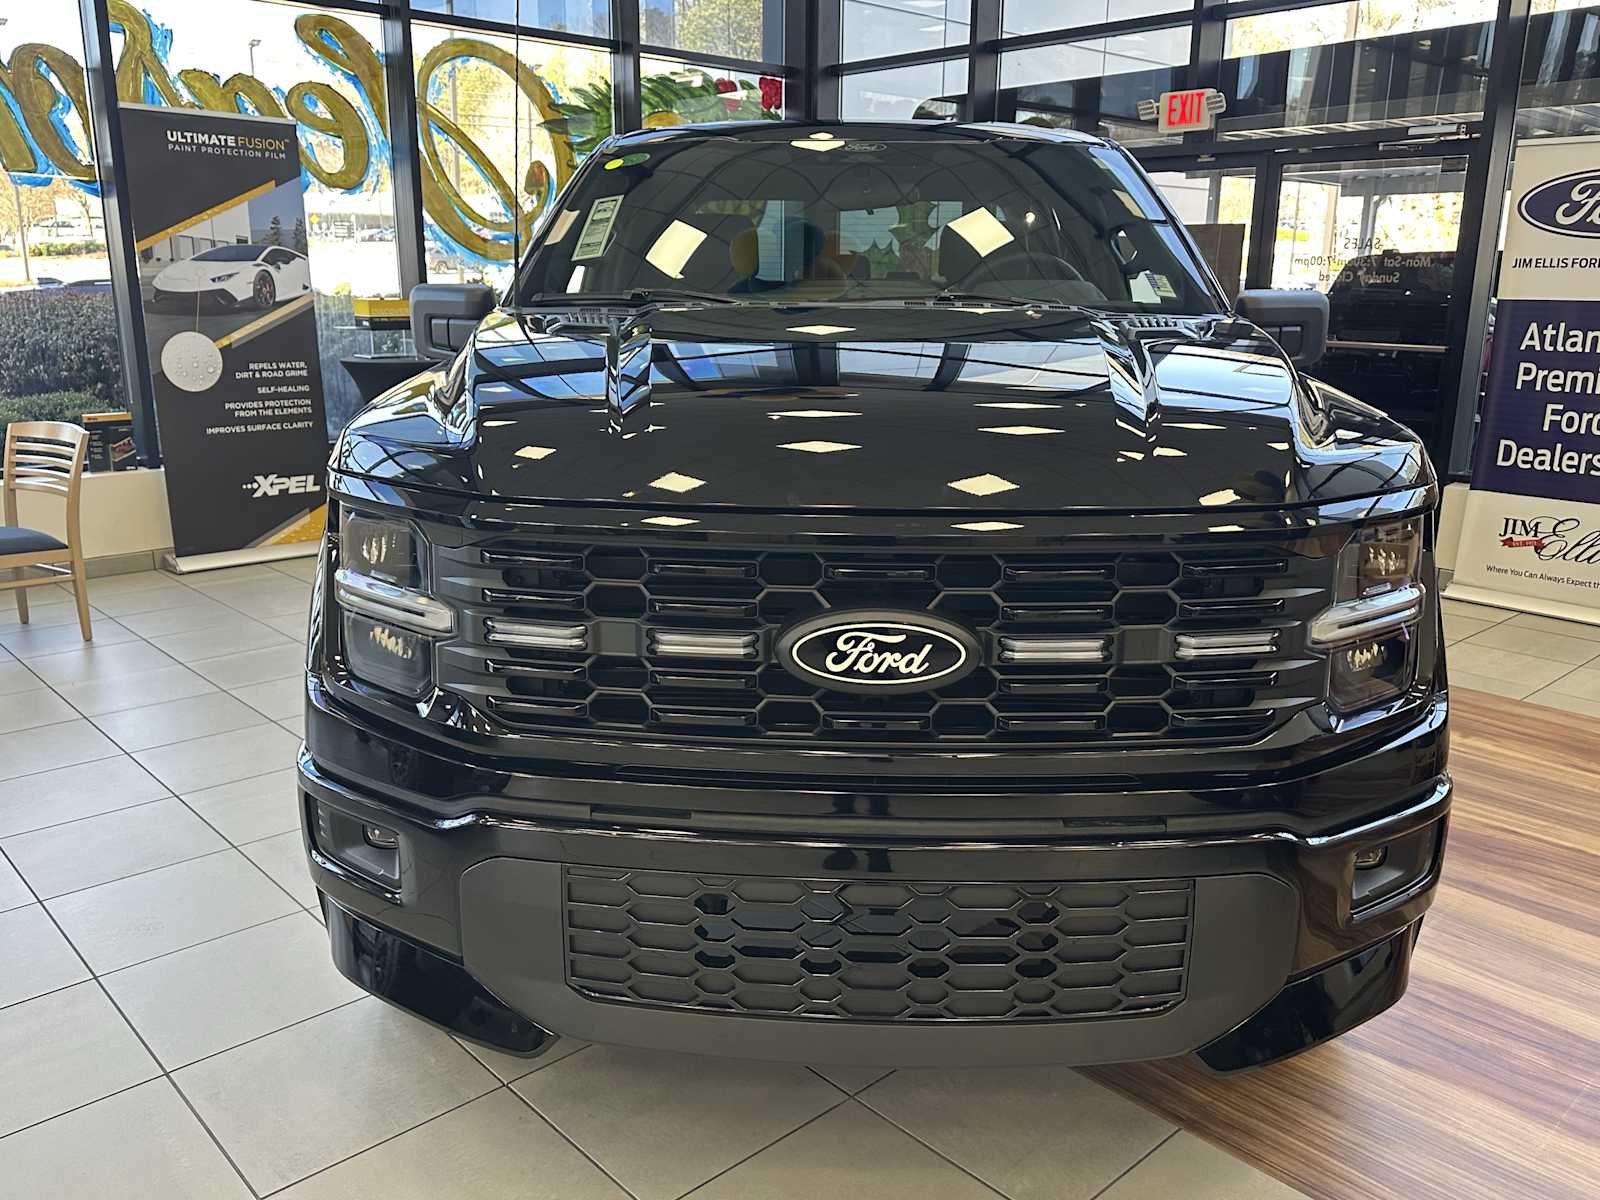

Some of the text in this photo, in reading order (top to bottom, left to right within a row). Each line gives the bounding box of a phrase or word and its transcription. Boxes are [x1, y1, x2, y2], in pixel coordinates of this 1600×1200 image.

[1167, 92, 1205, 126] EXIT
[166, 130, 236, 146] ULTIMATE
[168, 143, 286, 160] PAINT PROTECTION FILM
[1512, 257, 1600, 269] JIM ELLIS FOR
[249, 362, 278, 370] REPELS
[255, 371, 260, 379] &
[257, 385, 310, 394] SELF-HEALING
[225, 399, 312, 410] PROVIDES PROTECTION
[235, 410, 257, 418] FROM
[275, 407, 312, 415] ELEMENTS
[206, 421, 313, 435] IMPROVES SURFACE CLARITY
[1496, 439, 1600, 476] Dealers
[252, 474, 320, 498] XPEL
[1499, 517, 1541, 538] JIM
[1486, 564, 1508, 574] Where
[1510, 568, 1523, 577] You
[1524, 570, 1538, 579] Can
[1539, 573, 1565, 584] Always
[1566, 577, 1592, 587] Expect
[825, 631, 933, 674] Ford
